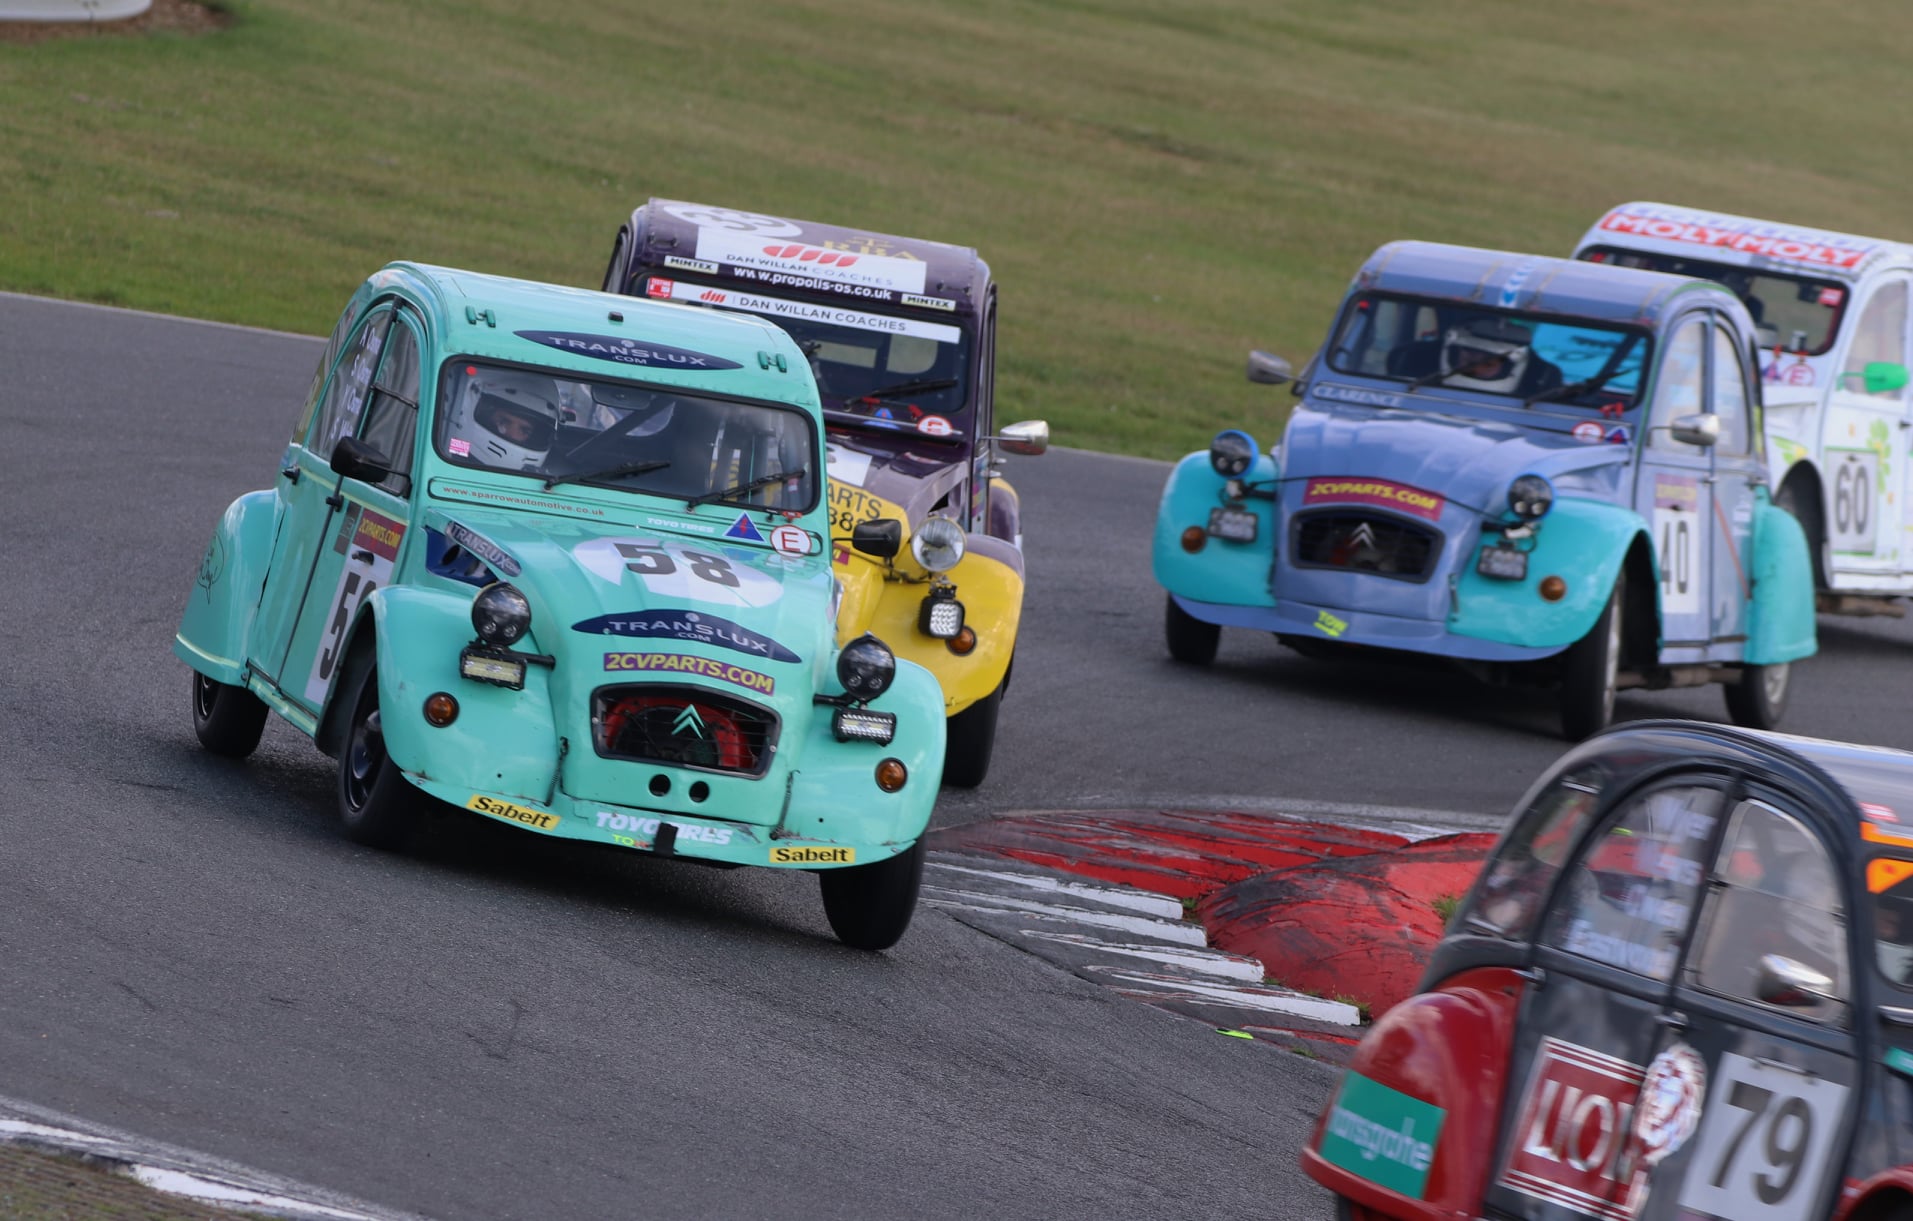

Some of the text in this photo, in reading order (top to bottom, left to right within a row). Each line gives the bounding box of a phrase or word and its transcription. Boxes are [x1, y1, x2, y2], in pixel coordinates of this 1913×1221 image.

[1607, 213, 1728, 246] MOLY
[670, 257, 713, 271] MINTEX
[1731, 234, 1861, 267] MOLY
[726, 253, 893, 286] DAN WILLAN COACHES
[739, 297, 906, 331] DAN WILLAN COACHES
[906, 295, 950, 308] MINTEX
[548, 336, 707, 366] TRANSLUX
[442, 485, 605, 516] www.sparrowautomotive.co.uk
[1835, 463, 1870, 535] 60
[647, 517, 714, 533] TOYO TIRES
[452, 523, 507, 569] TRANSLUX
[780, 531, 801, 553] E
[1660, 520, 1689, 595] 40
[613, 542, 741, 588] 58
[608, 620, 768, 654] TRANSLUX
[605, 653, 774, 693] 2CVPARTS.COM
[474, 796, 552, 829] Sabelt
[596, 811, 661, 835] TOYO
[775, 848, 851, 862] Sabelt
[1709, 1079, 1813, 1206] 79
